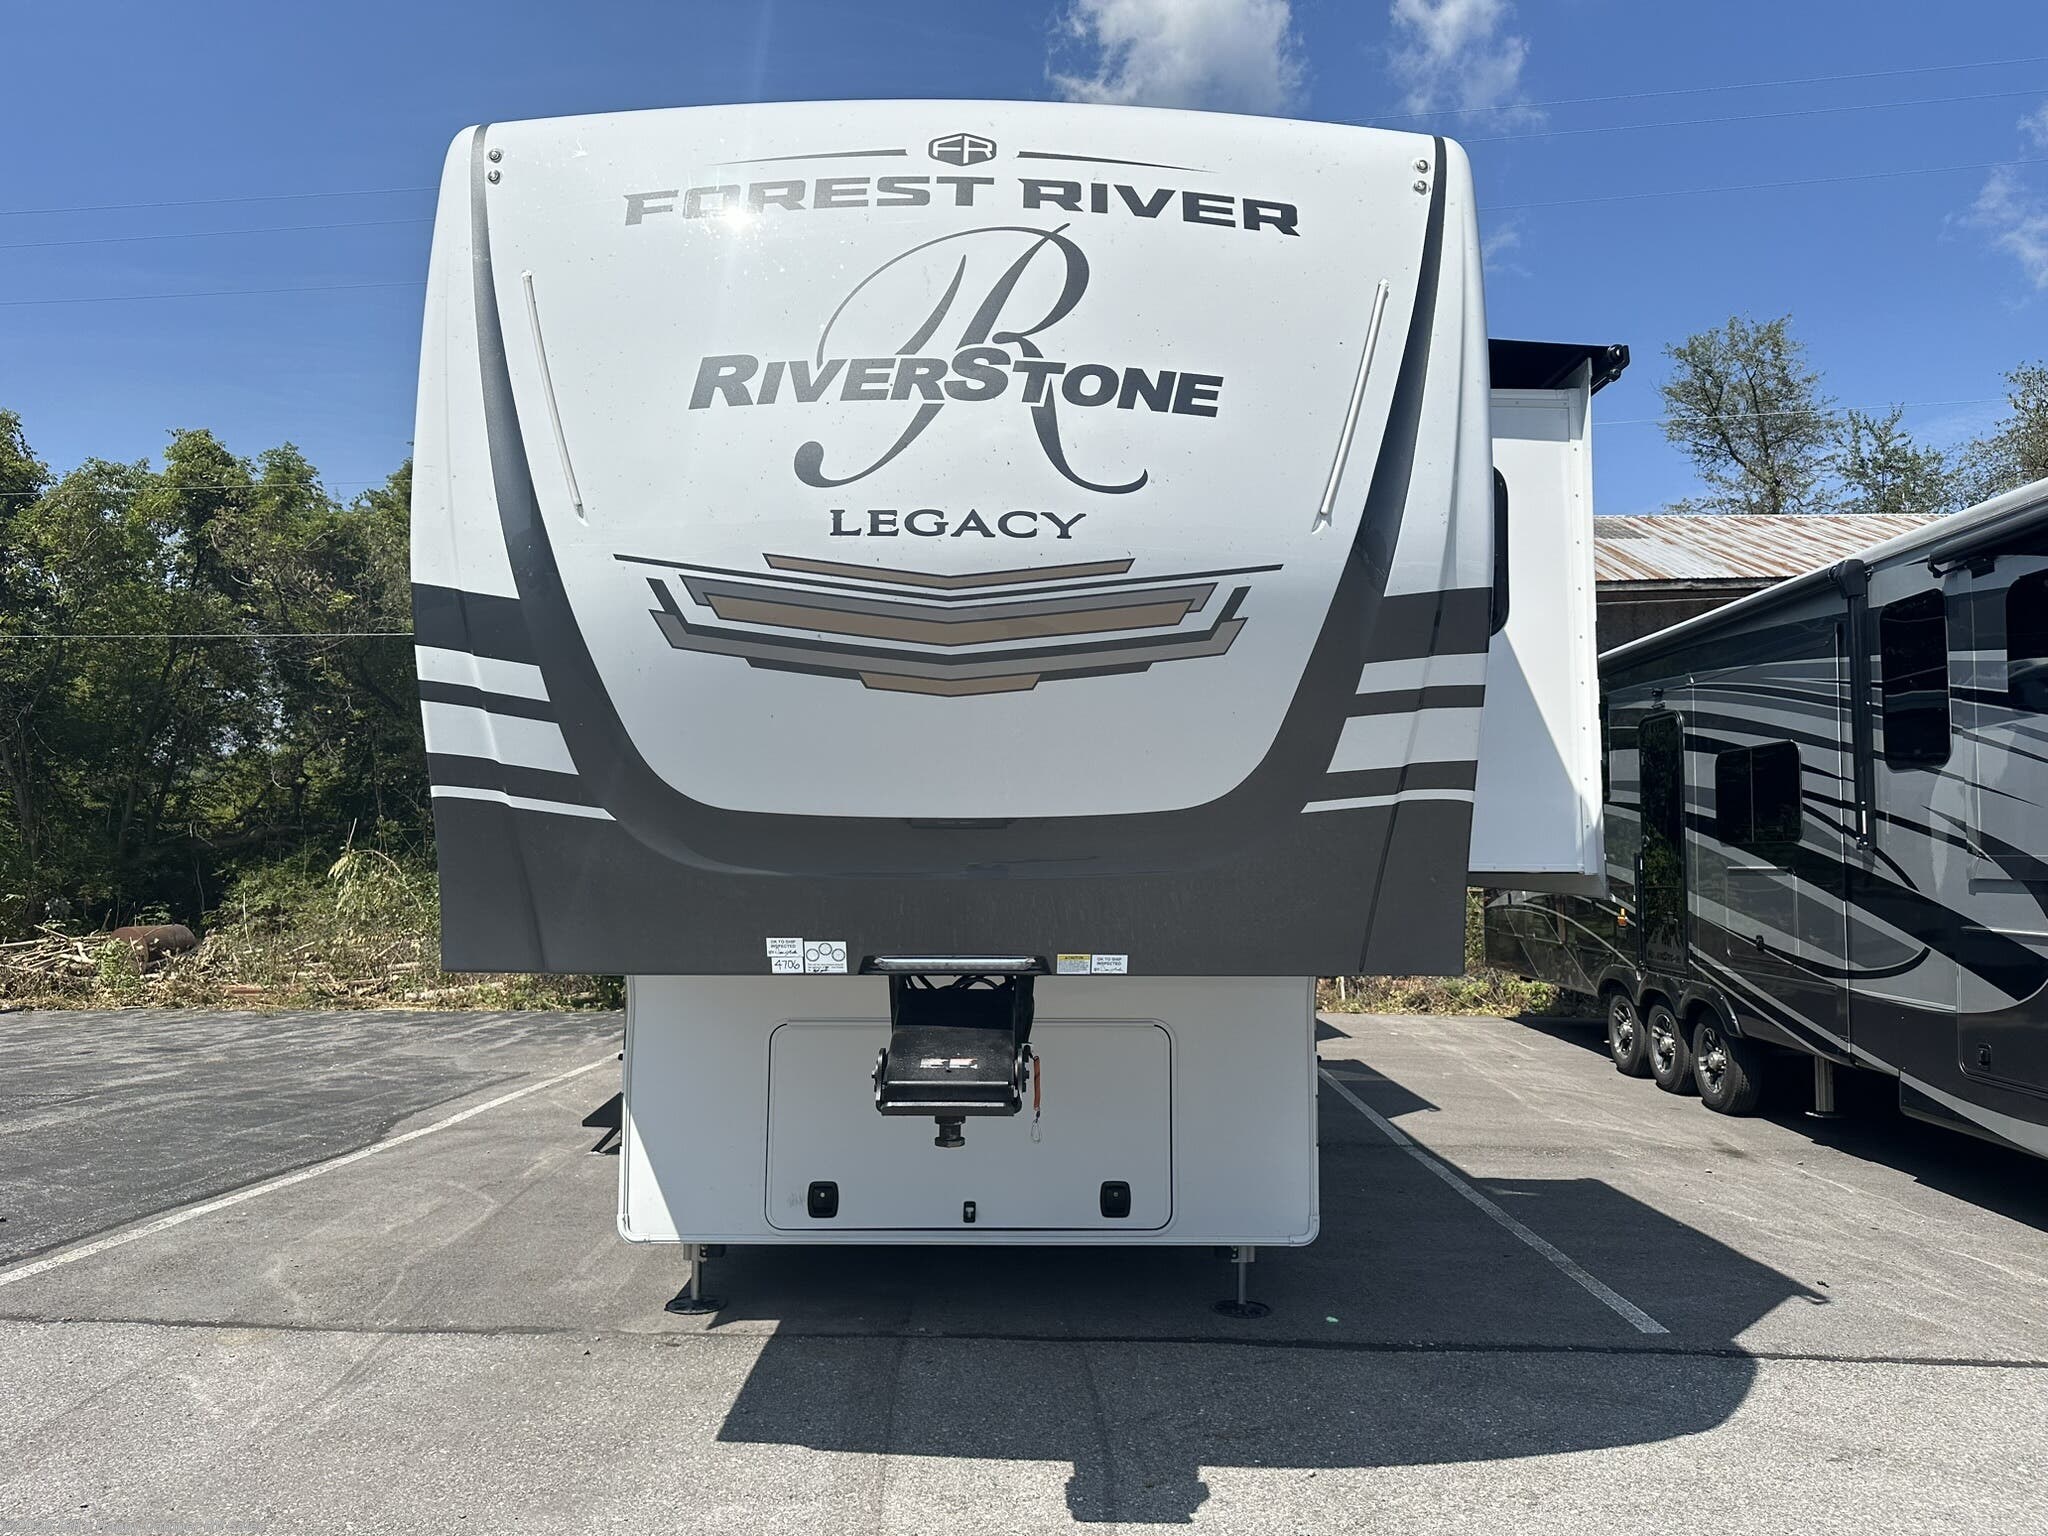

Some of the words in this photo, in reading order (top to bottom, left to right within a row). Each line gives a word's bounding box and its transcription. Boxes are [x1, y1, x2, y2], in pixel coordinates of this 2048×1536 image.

[623, 176, 994, 226] FOREST
[1017, 177, 1301, 237] RIVER
[688, 346, 1224, 418] RIVERSTONE
[829, 508, 1087, 540] LEGACY
[774, 959, 801, 971] 4706
